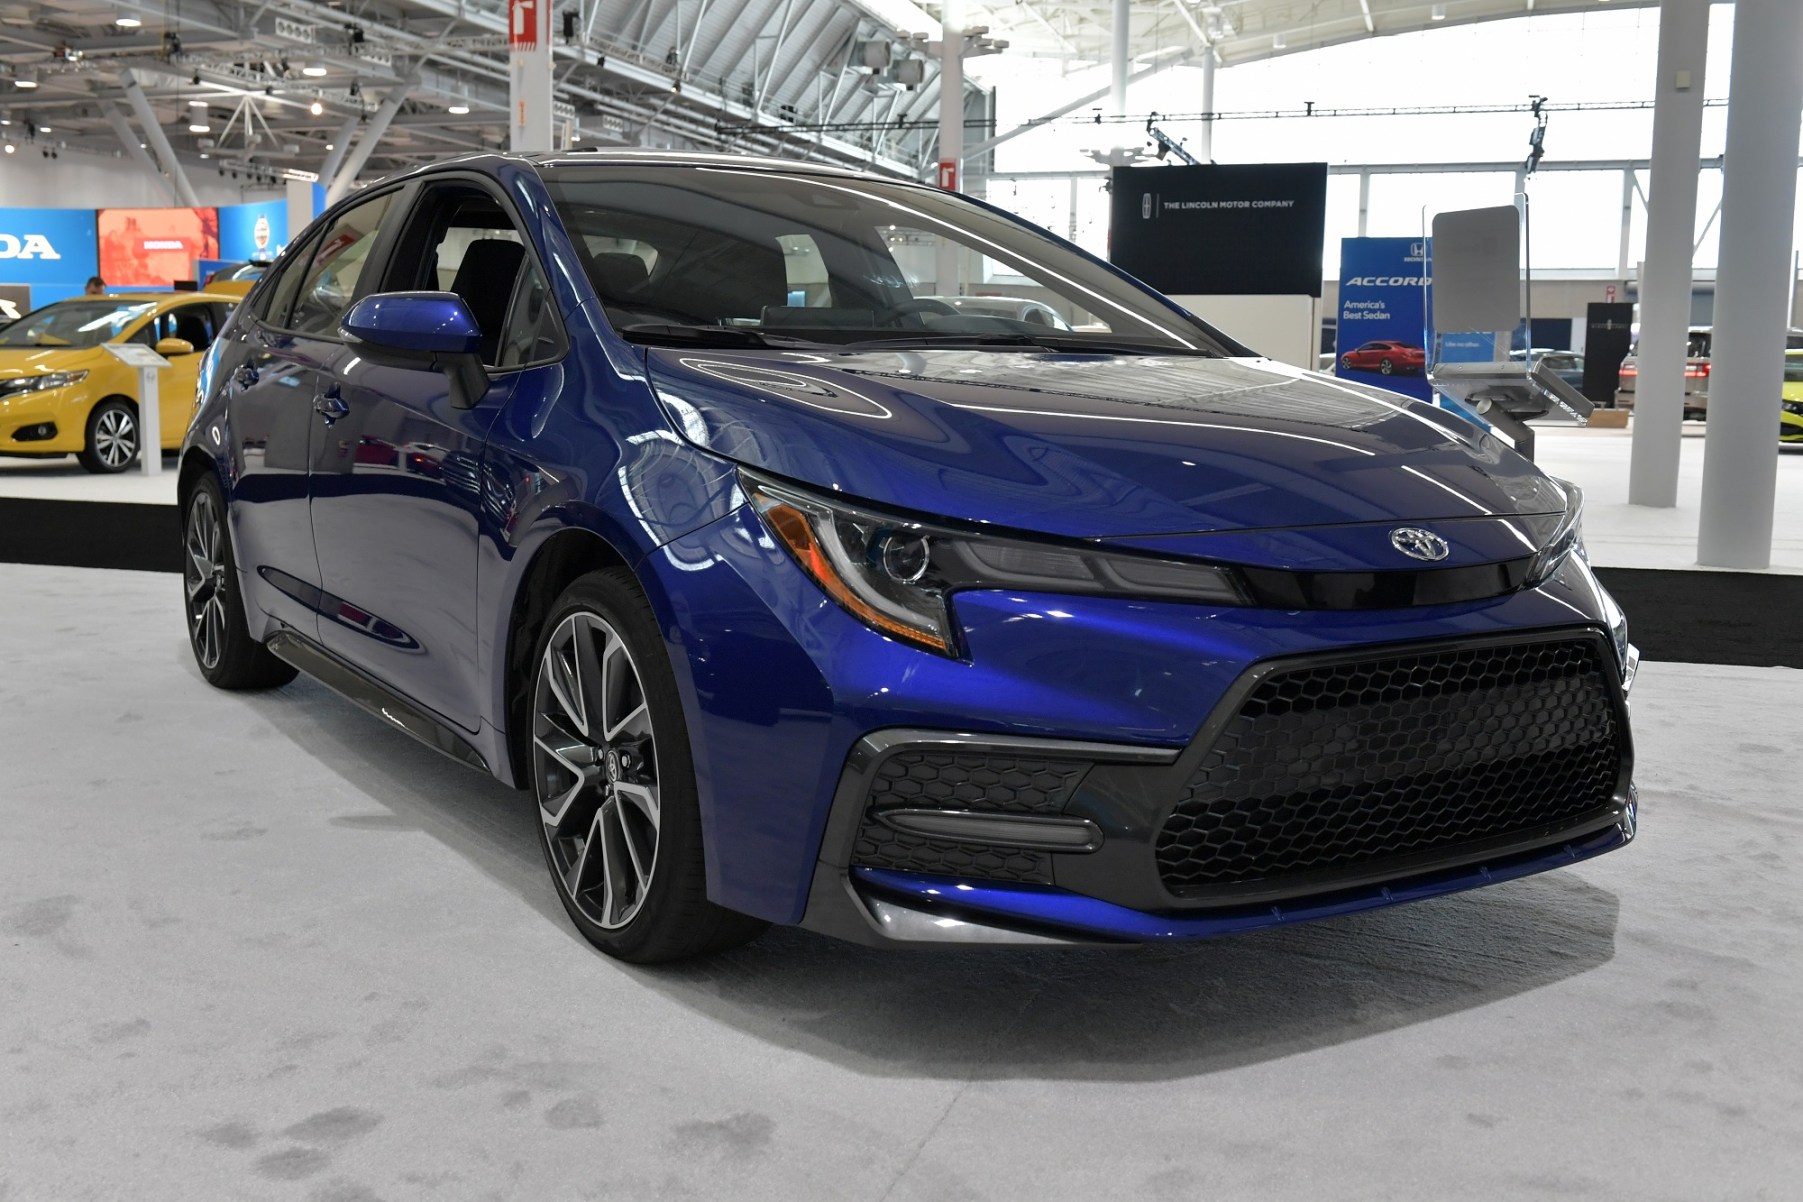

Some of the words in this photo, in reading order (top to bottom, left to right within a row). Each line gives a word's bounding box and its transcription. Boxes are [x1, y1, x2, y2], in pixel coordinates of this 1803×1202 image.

[1181, 201, 1218, 209] LINCOLN
[1251, 200, 1295, 208] COMPANY
[144, 240, 184, 250] HONDA
[1345, 277, 1432, 286] ACCORD
[1344, 300, 1385, 309] America's
[1343, 311, 1361, 319] Best
[1363, 311, 1390, 319] Sedan
